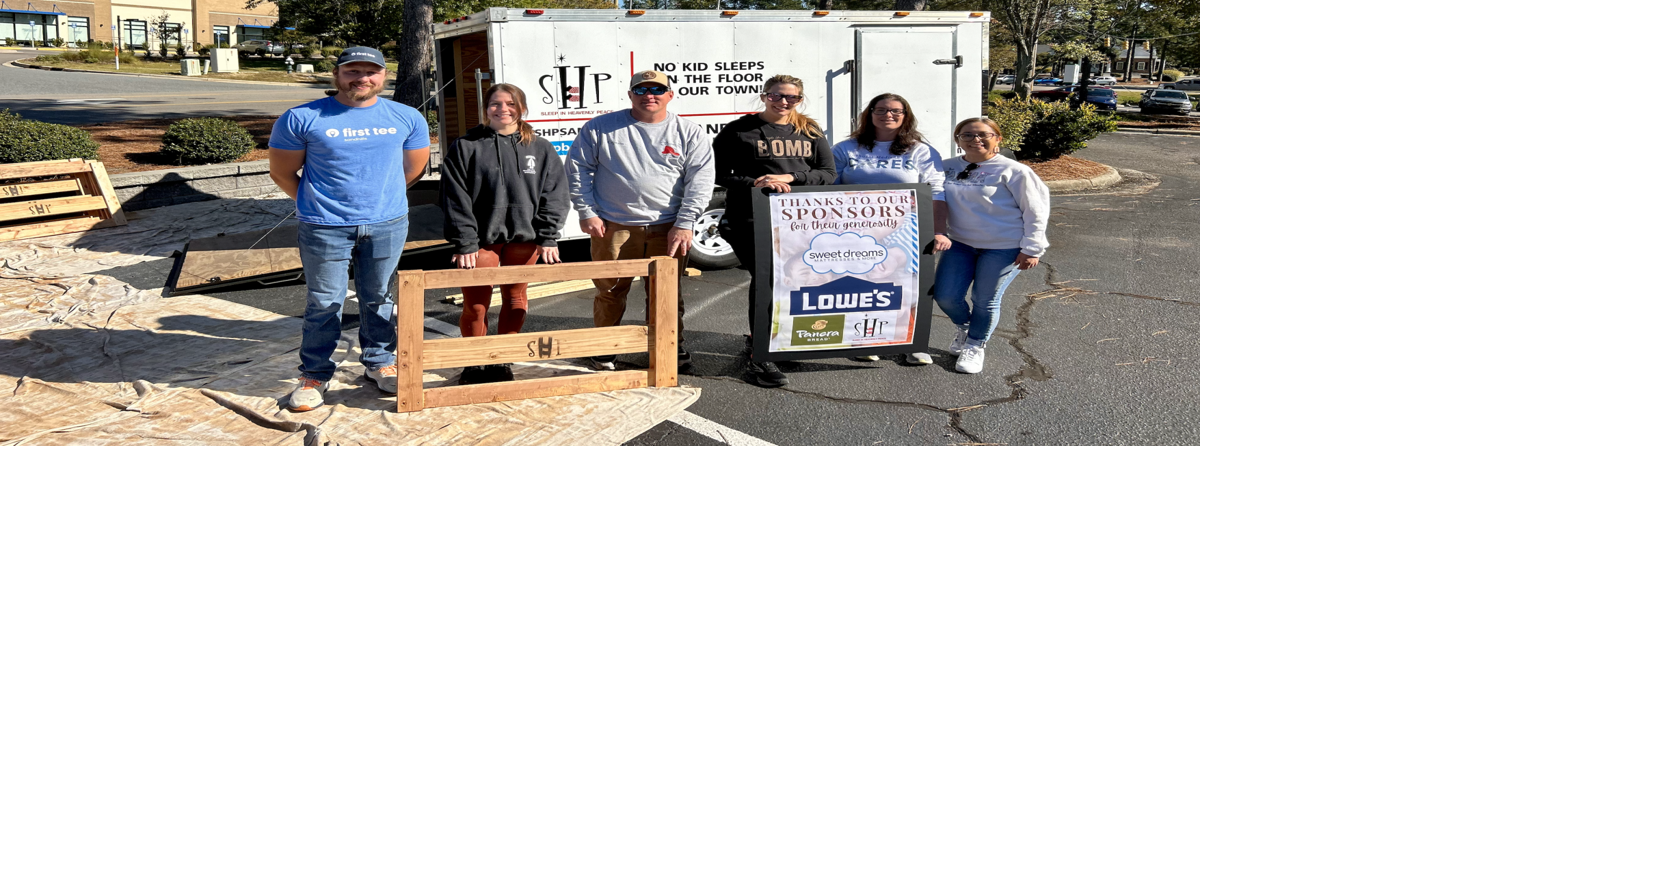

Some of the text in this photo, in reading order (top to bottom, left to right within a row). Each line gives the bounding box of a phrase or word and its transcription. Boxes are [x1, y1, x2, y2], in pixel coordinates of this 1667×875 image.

[654, 61, 765, 71] NO KID SLEEPS
[667, 73, 763, 84] N THE FLOOR
[539, 65, 612, 109] SHP
[678, 85, 763, 96] OUR TOWN!
[342, 127, 397, 137] first tee
[757, 140, 812, 157] BOMB
[778, 195, 909, 207] THANKS TO OUR
[781, 205, 905, 220] SPONSORS
[790, 218, 898, 231] for their generosity
[809, 249, 884, 259] sweet dreams
[802, 289, 891, 311] LOWE'S
[796, 330, 840, 338] Panera
